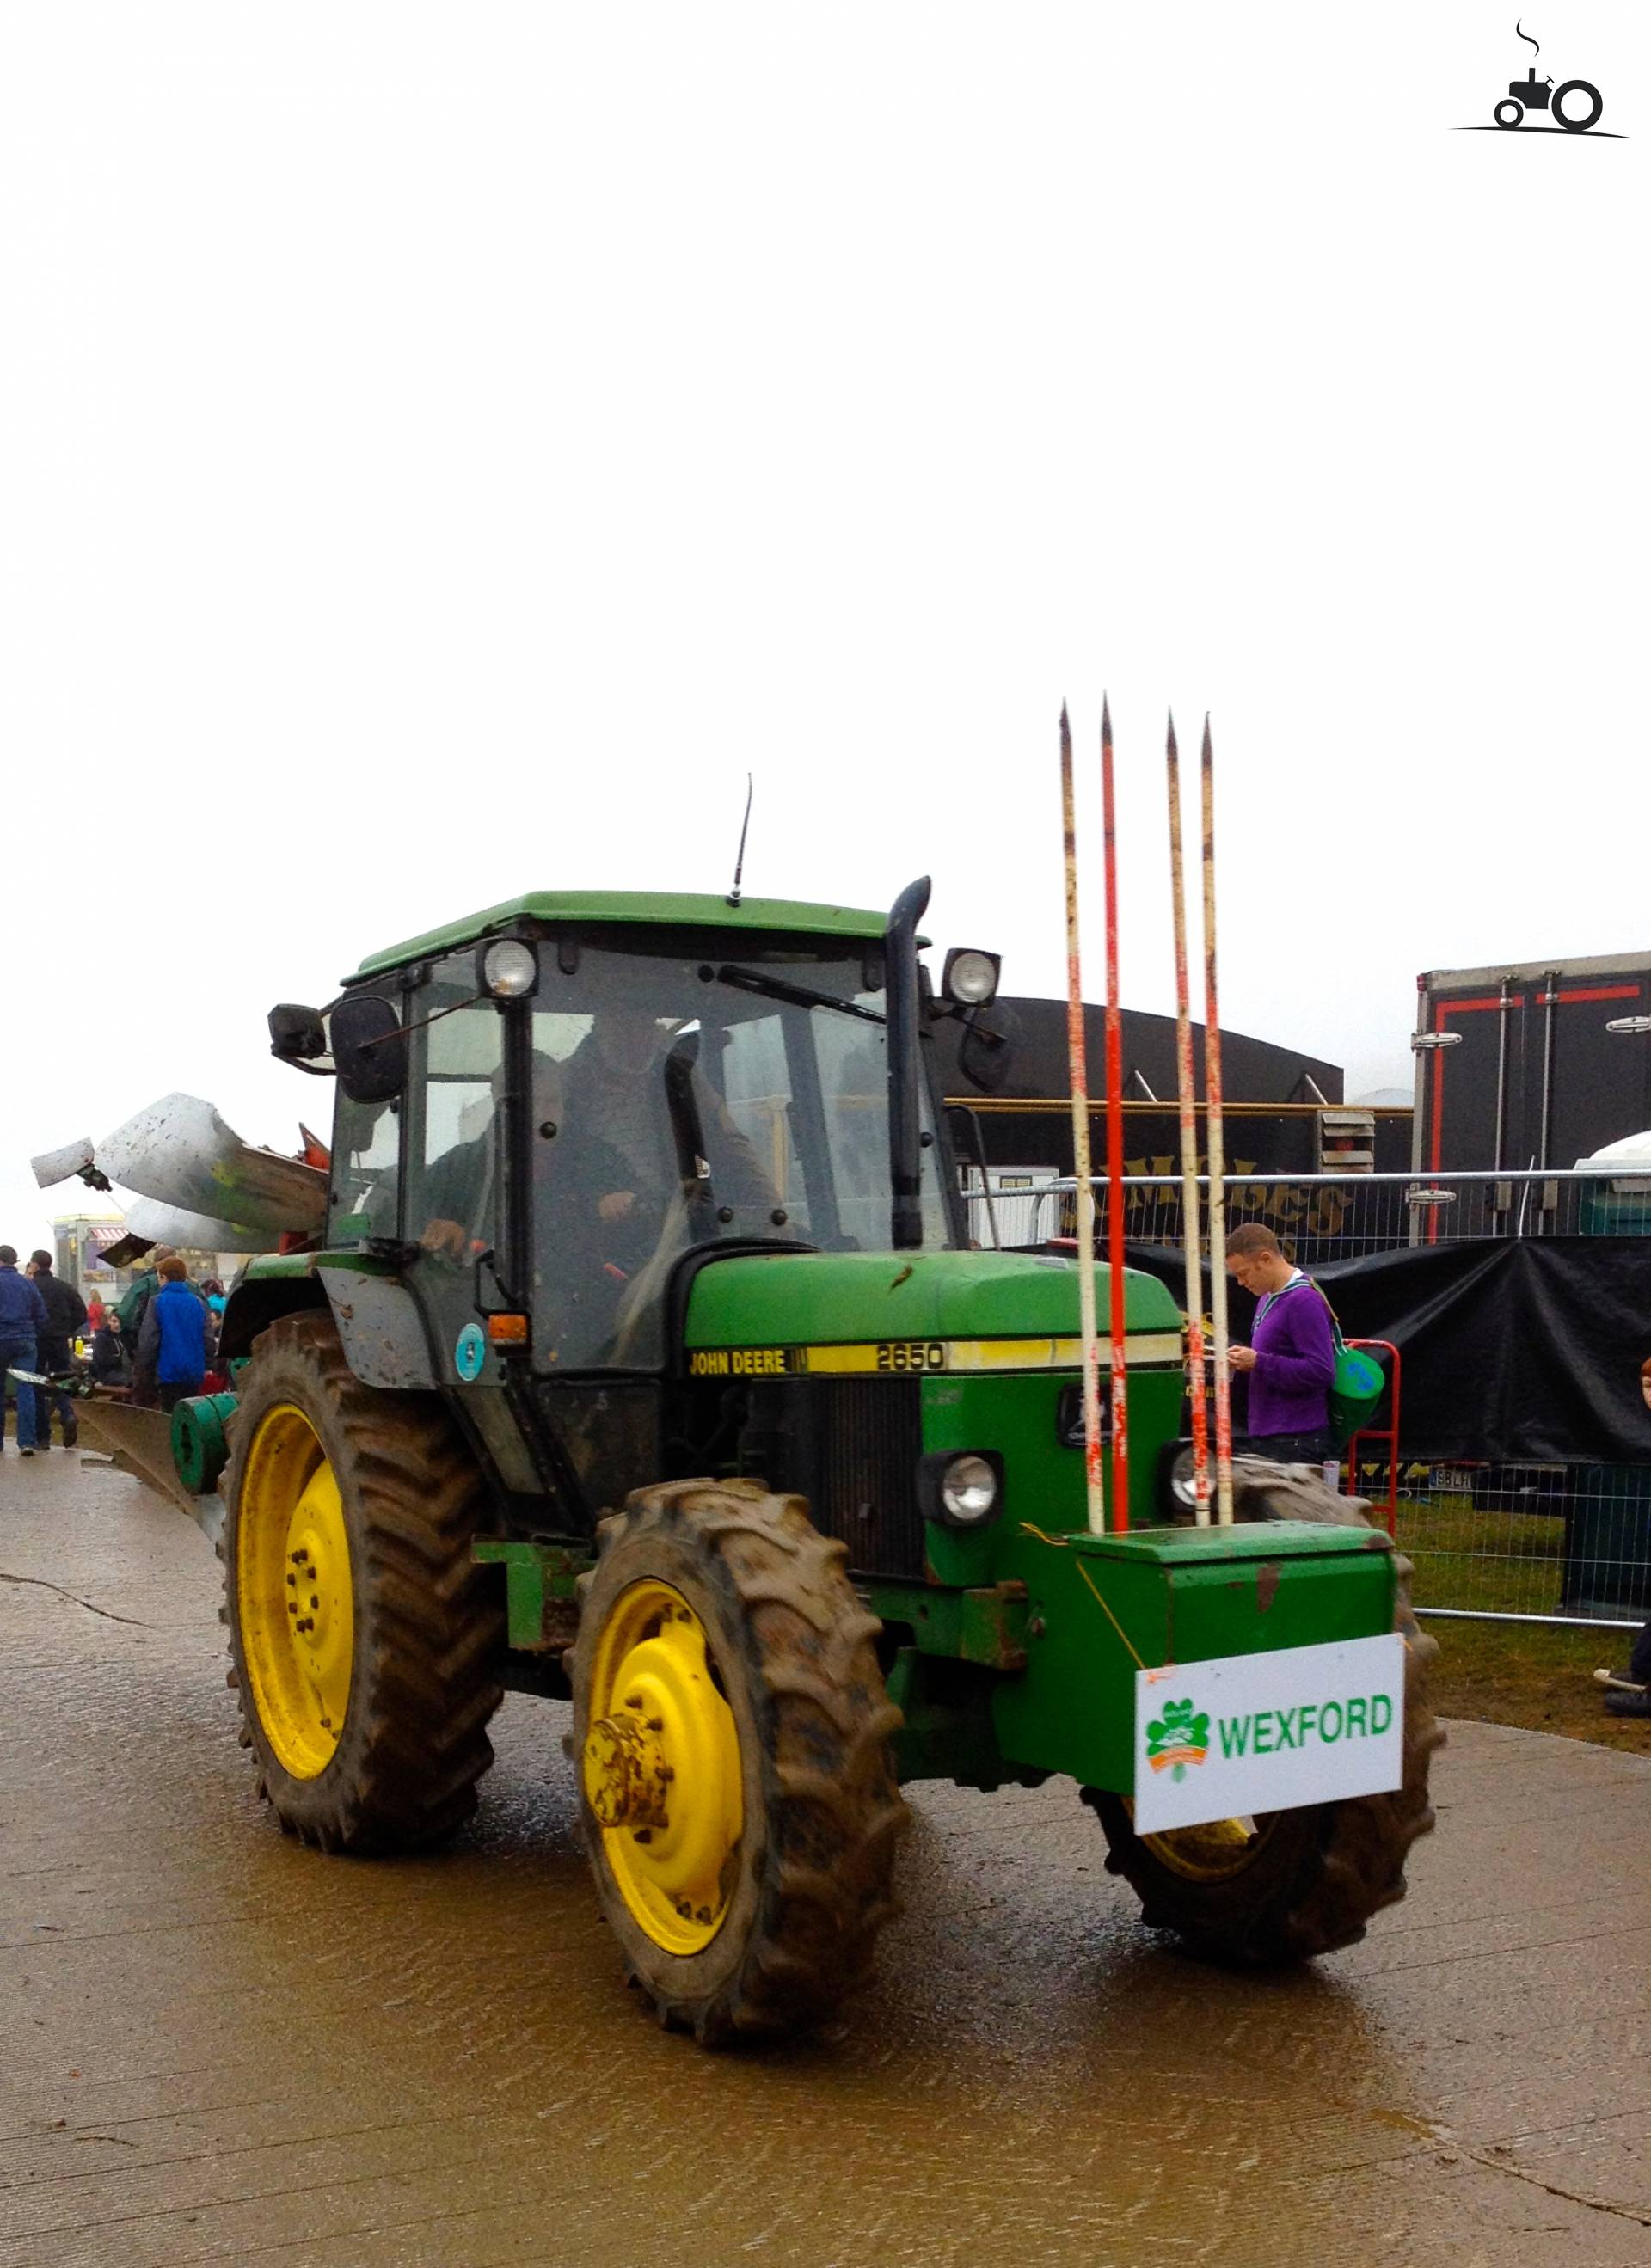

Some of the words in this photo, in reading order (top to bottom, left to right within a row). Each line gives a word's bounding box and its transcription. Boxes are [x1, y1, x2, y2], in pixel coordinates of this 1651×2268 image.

[690, 1352, 728, 1374] JOHN
[733, 1351, 784, 1373] DEERE
[877, 1343, 944, 1370] 2650
[1218, 1694, 1393, 1759] WEXFORD
